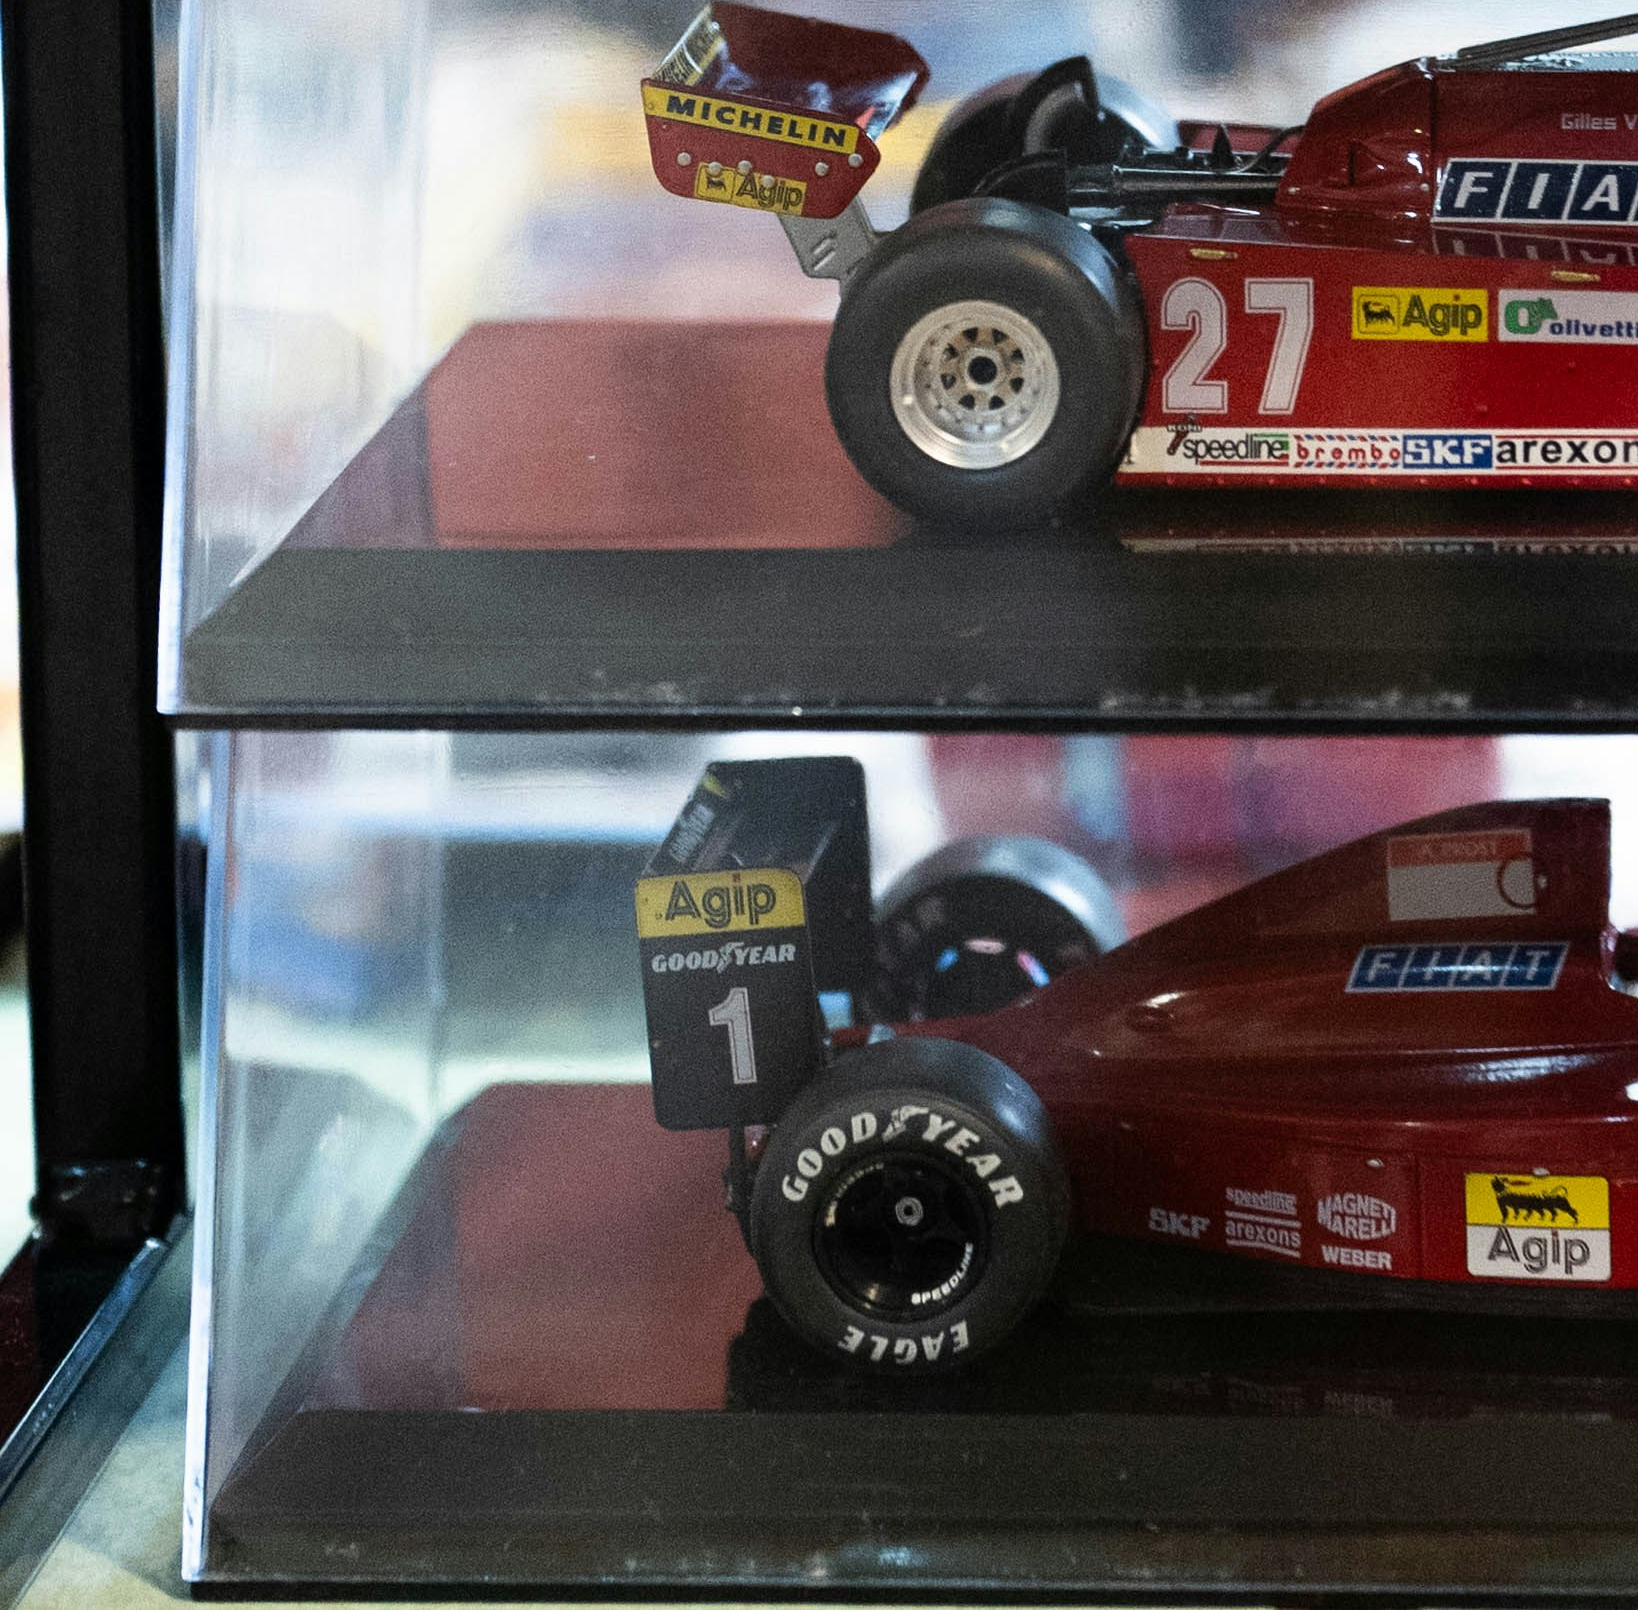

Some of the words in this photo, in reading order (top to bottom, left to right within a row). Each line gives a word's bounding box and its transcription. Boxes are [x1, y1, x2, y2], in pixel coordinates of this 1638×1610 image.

[665, 94, 847, 148] MICHELIN
[1561, 112, 1617, 131] Gilles
[735, 175, 804, 211] Agip
[1401, 293, 1482, 336] Agip
[1160, 276, 1315, 415] 27
[1182, 433, 1284, 466] speedline
[1296, 436, 1401, 462] brembo
[1404, 438, 1491, 465] SKF
[665, 873, 778, 929] Agip
[650, 941, 797, 974] GOODYEAR
[1367, 949, 1549, 982] FIAT
[708, 986, 758, 1085] 1
[782, 1104, 1026, 1211] GOODYEAR
[1317, 1192, 1397, 1220] MAGNETI
[1225, 1220, 1301, 1248] arexons
[1486, 1222, 1591, 1274] Agip
[1321, 1244, 1393, 1271] WEBER
[838, 1319, 970, 1365] EAGLE
